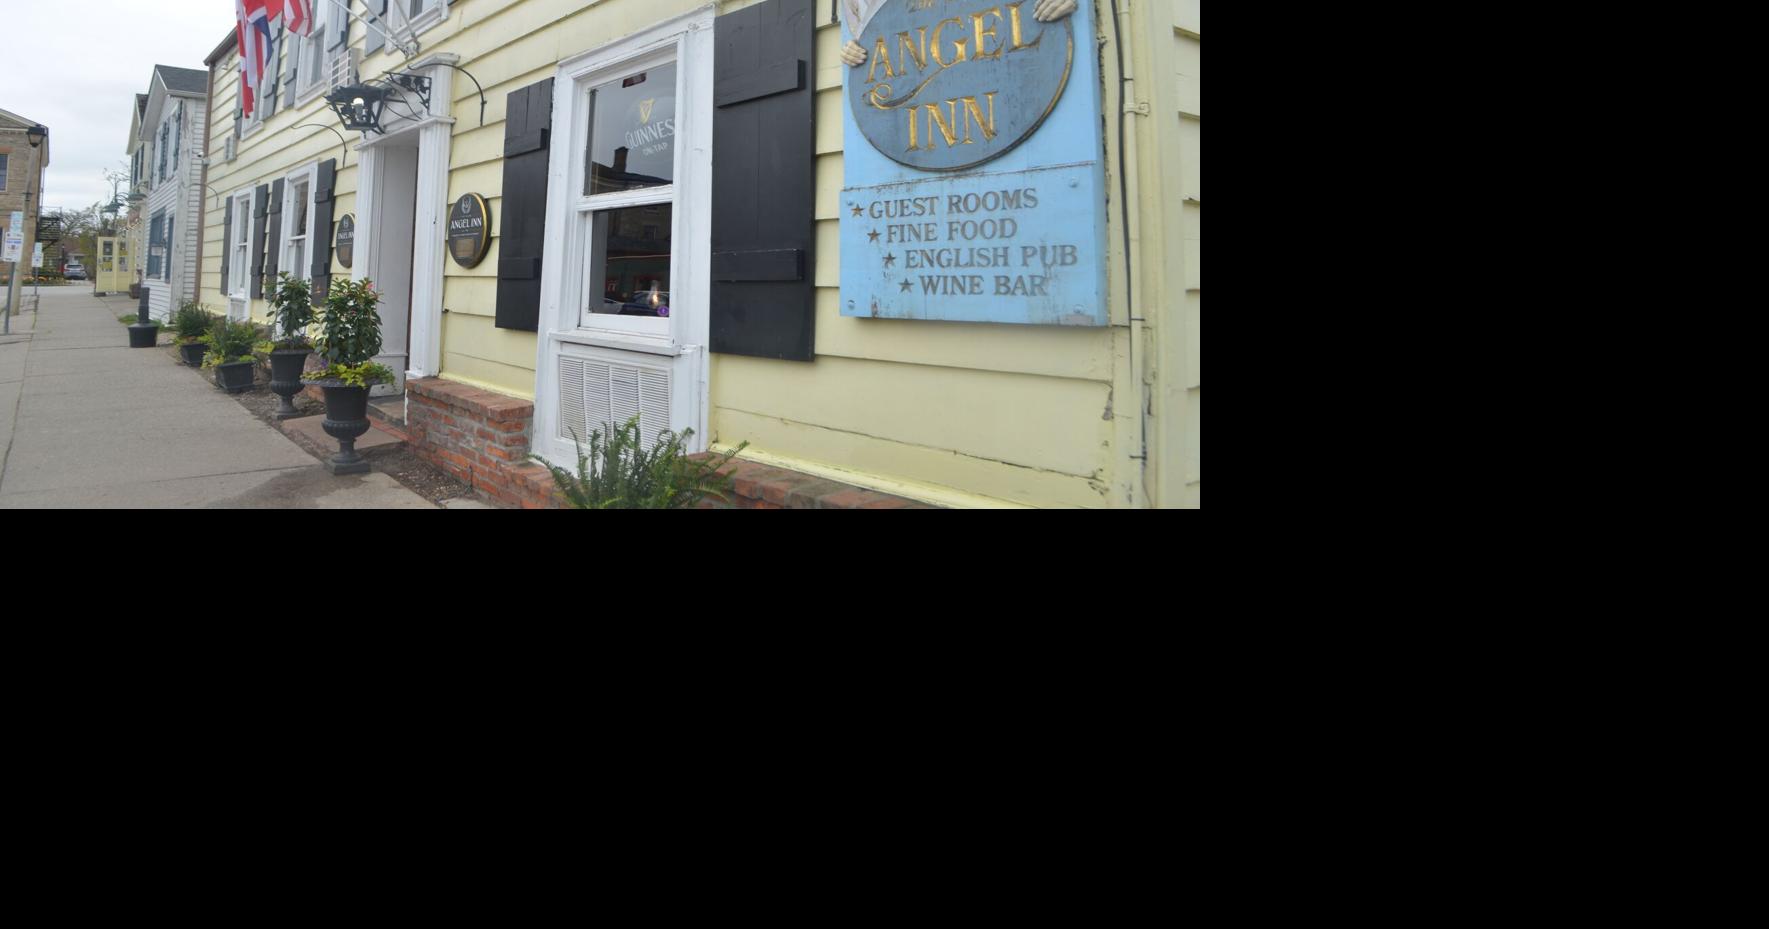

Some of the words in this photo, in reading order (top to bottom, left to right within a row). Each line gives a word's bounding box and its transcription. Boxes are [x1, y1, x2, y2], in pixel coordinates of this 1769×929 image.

[865, 0, 1044, 83] ANGEL
[625, 118, 675, 150] GUINNES
[905, 91, 999, 152] INN
[869, 196, 940, 219] GUEST
[947, 188, 1039, 214] ROOMS
[451, 218, 470, 230] ANGEL
[471, 216, 482, 228] INN
[886, 222, 938, 244] FINE
[947, 217, 1018, 241] FOOD
[905, 246, 1010, 269] ENGLISH
[1021, 244, 1078, 268] PUB
[920, 275, 985, 296] WINE
[993, 274, 1050, 297] BAR
